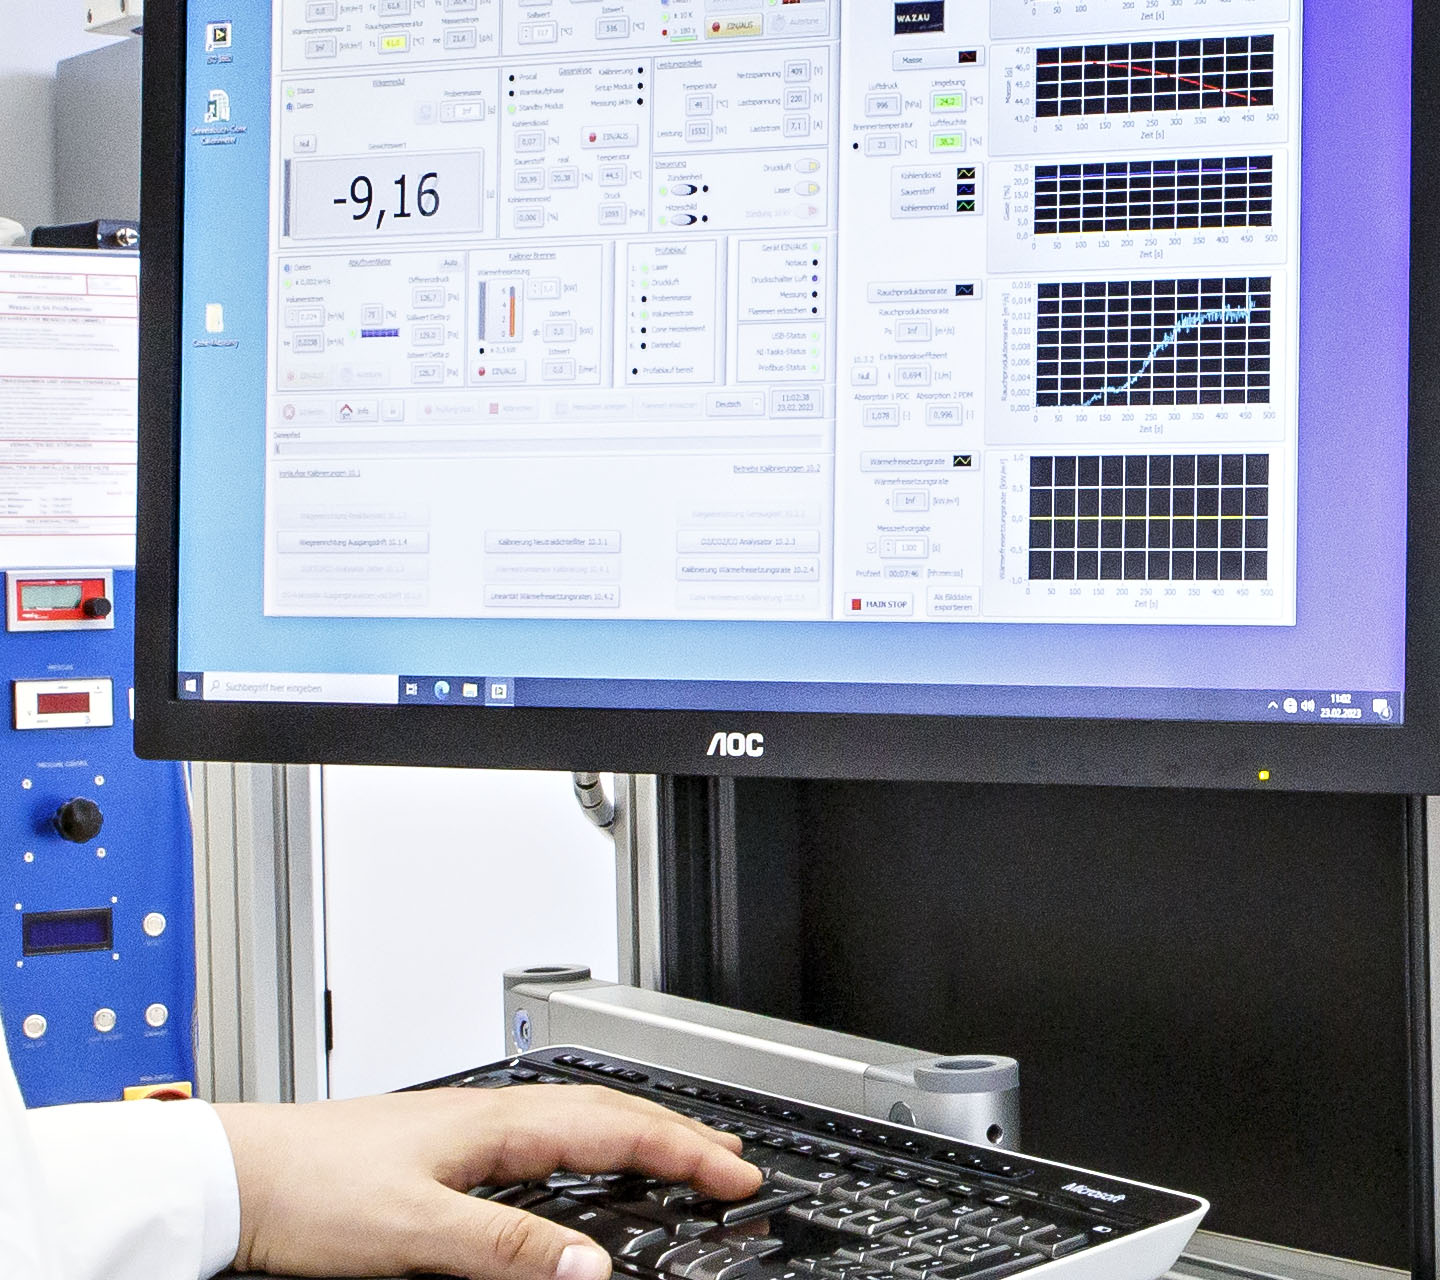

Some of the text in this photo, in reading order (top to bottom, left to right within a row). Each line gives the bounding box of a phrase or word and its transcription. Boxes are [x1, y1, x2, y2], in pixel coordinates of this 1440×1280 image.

[897, 14, 930, 22] WAZAU
[682, 81, 717, 92] Temperatur
[519, 103, 543, 113] Standby
[333, 172, 441, 230] -9,16
[715, 400, 741, 409] Deutsch
[866, 600, 907, 608] MAIN STOP
[934, 604, 972, 612] exportieren
[226, 681, 268, 694] Suchbegriff
[287, 683, 322, 696] eingeben
[1331, 694, 1351, 704] 11:02
[1320, 708, 1362, 718] 23.02.2023
[706, 731, 764, 757] AOC
[1061, 1182, 1126, 1203] Microsoft
